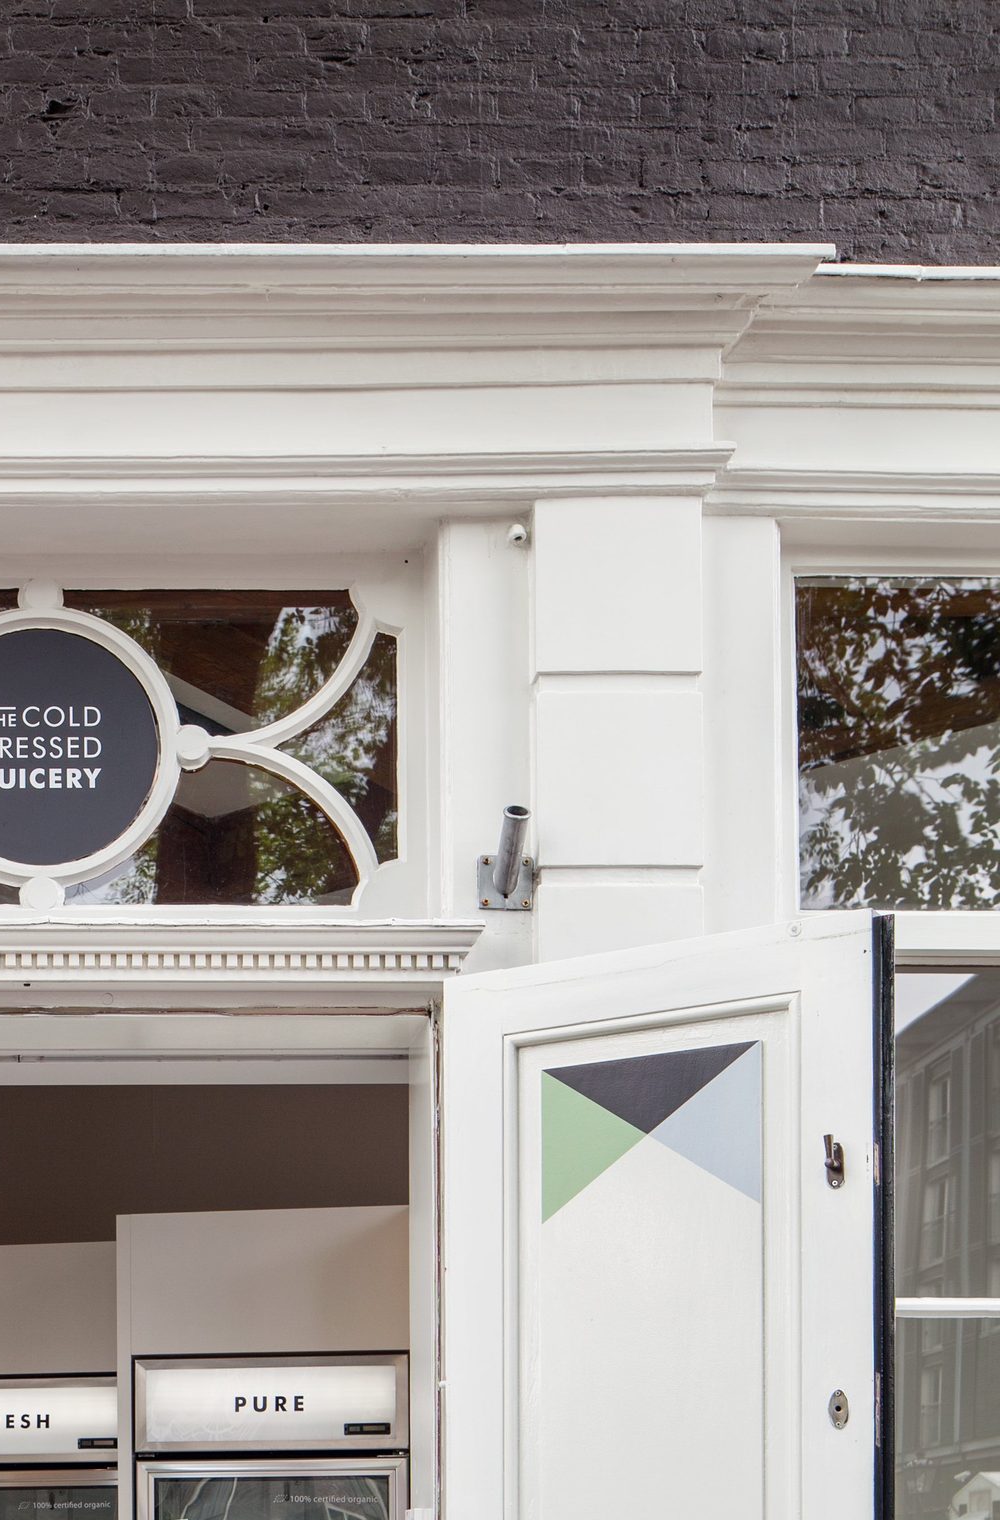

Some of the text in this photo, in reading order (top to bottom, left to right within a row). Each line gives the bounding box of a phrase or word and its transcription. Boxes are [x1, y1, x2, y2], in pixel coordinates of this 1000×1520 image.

[22, 705, 102, 728] COLD
[234, 1395, 305, 1413] PURE
[32, 1500, 111, 1511] 100% certified organic
[290, 1495, 379, 1505] 100% certified organic
